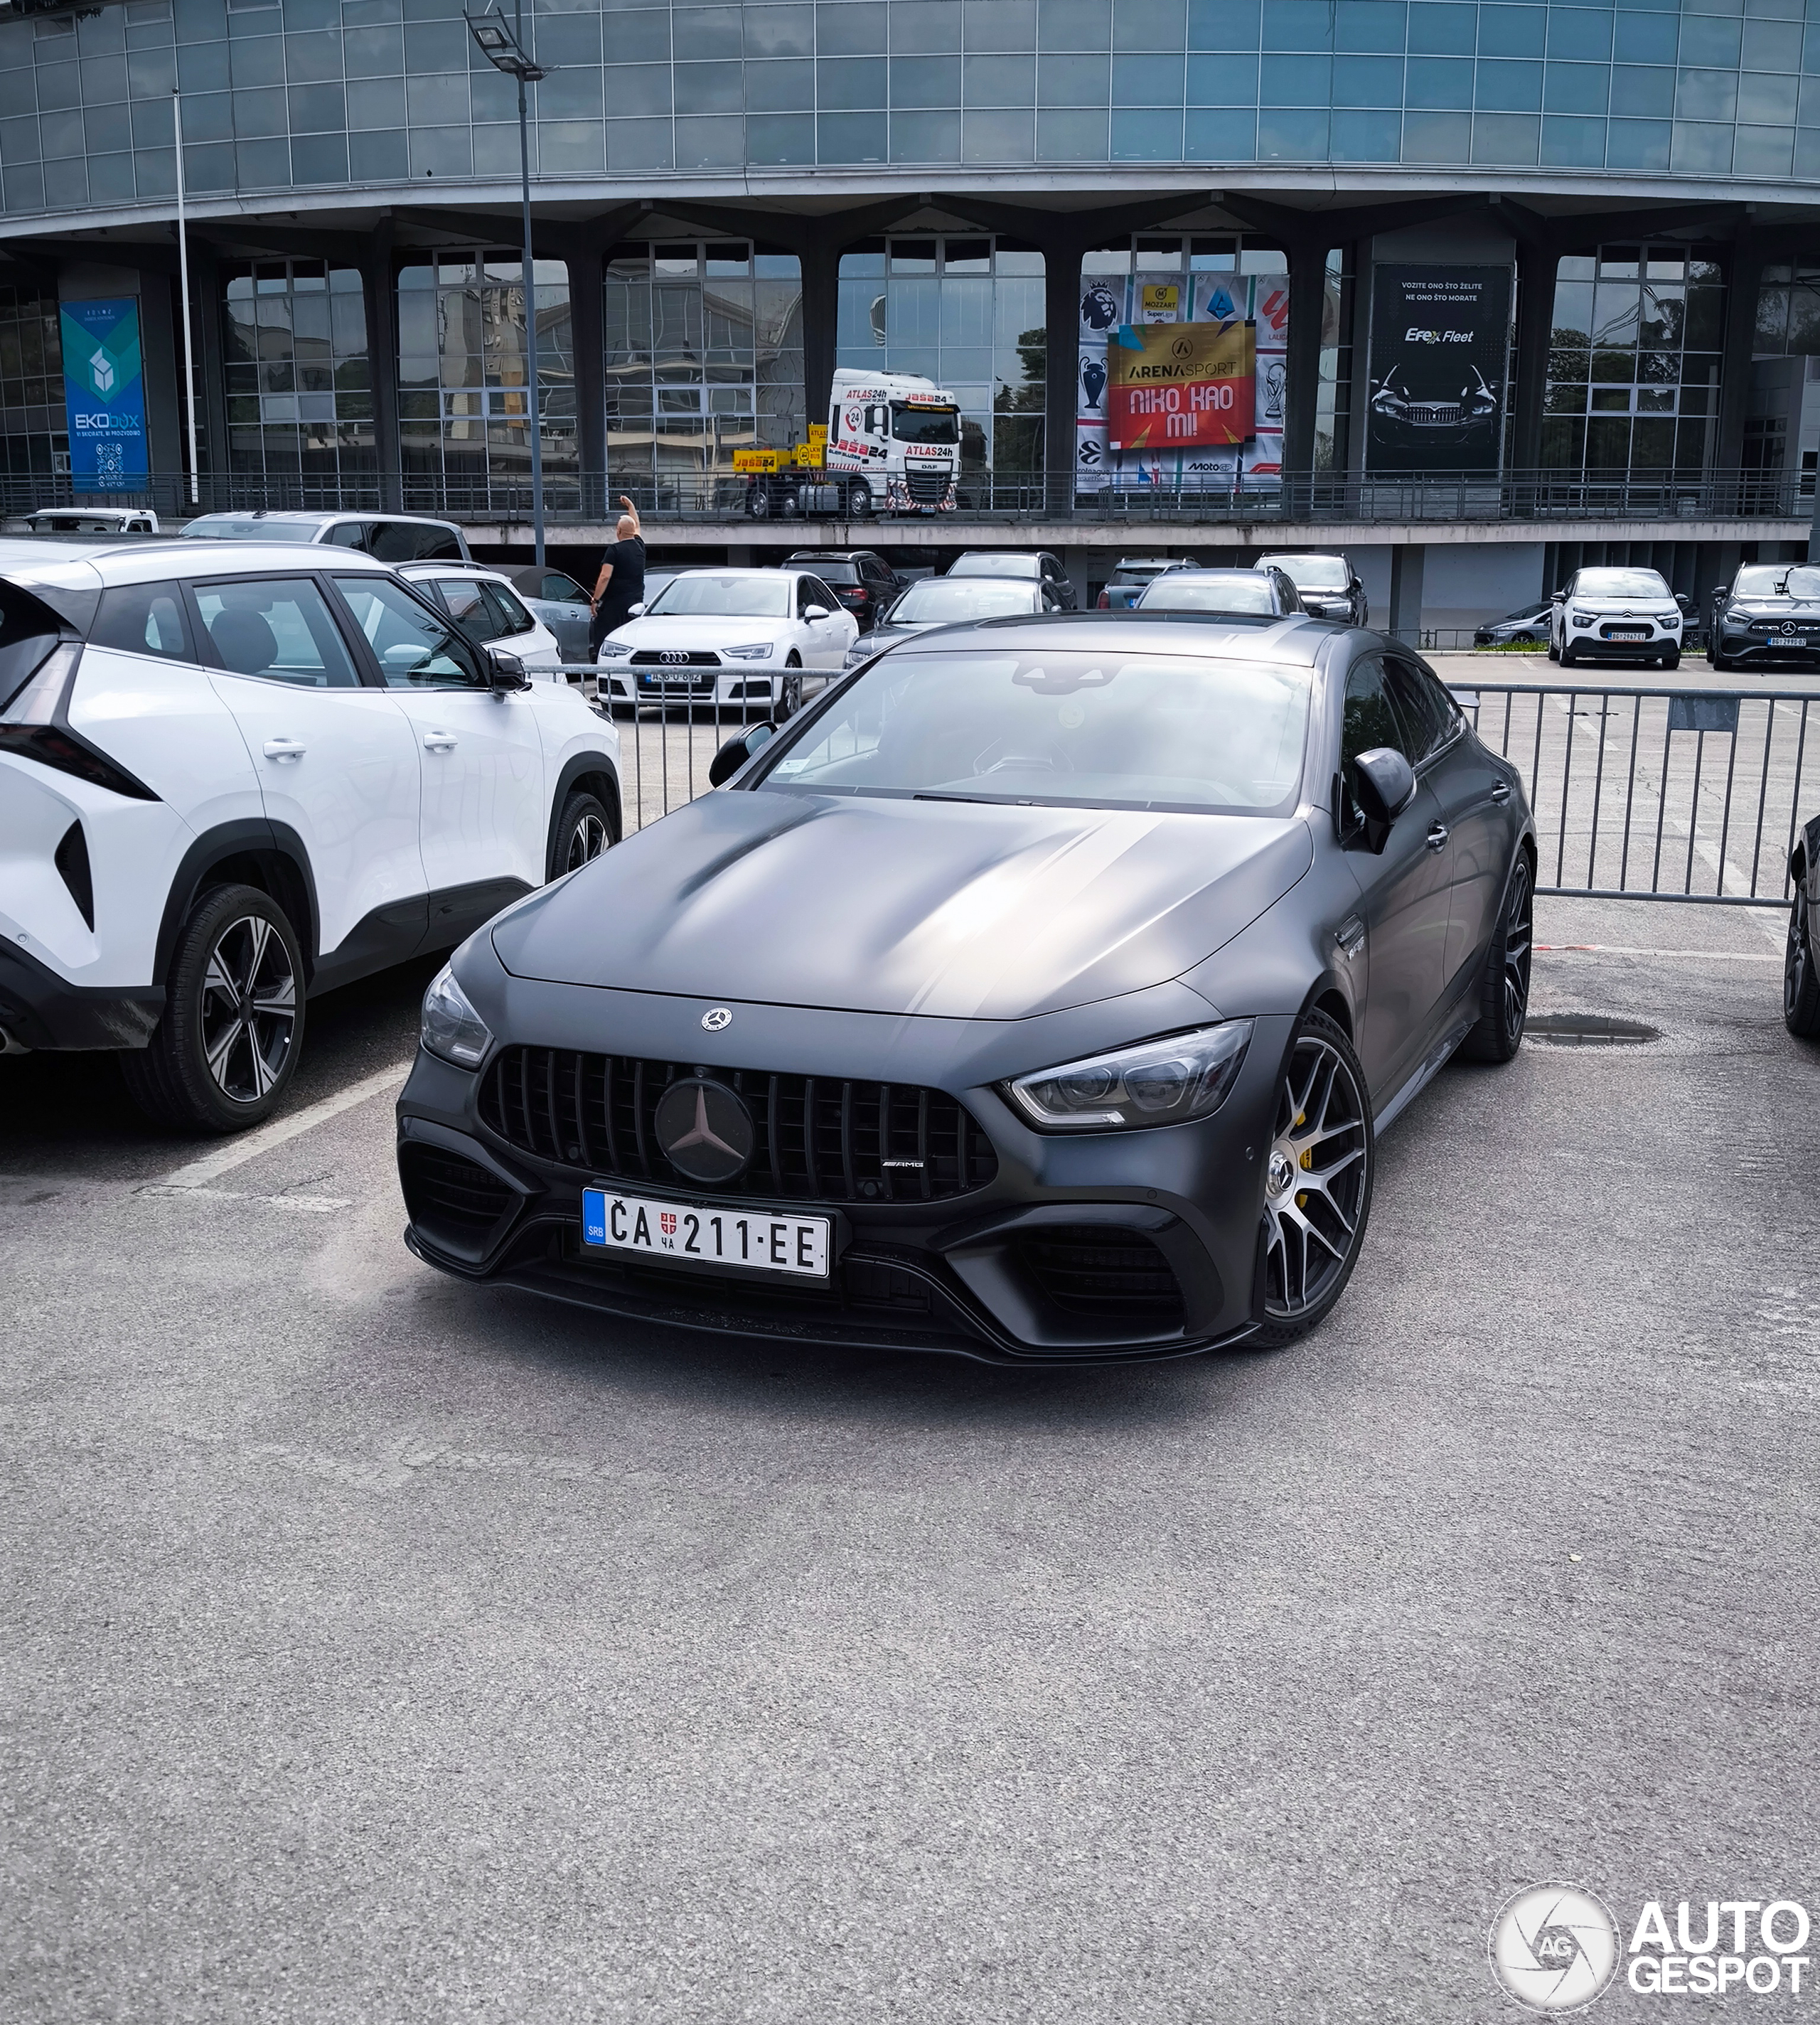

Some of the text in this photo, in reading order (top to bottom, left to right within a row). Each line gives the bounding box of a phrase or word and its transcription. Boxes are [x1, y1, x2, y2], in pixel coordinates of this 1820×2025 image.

[1442, 331, 1474, 342] Fleet
[847, 390, 887, 398] ATLAS24h
[1130, 385, 1233, 414] NIKO KAO
[851, 413, 860, 422] 24
[1167, 412, 1197, 437] MI!
[906, 446, 953, 456] ATLAS24h
[1189, 463, 1233, 471] MotoGP
[611, 1199, 652, 1246] ČA
[588, 1225, 604, 1237] SRB
